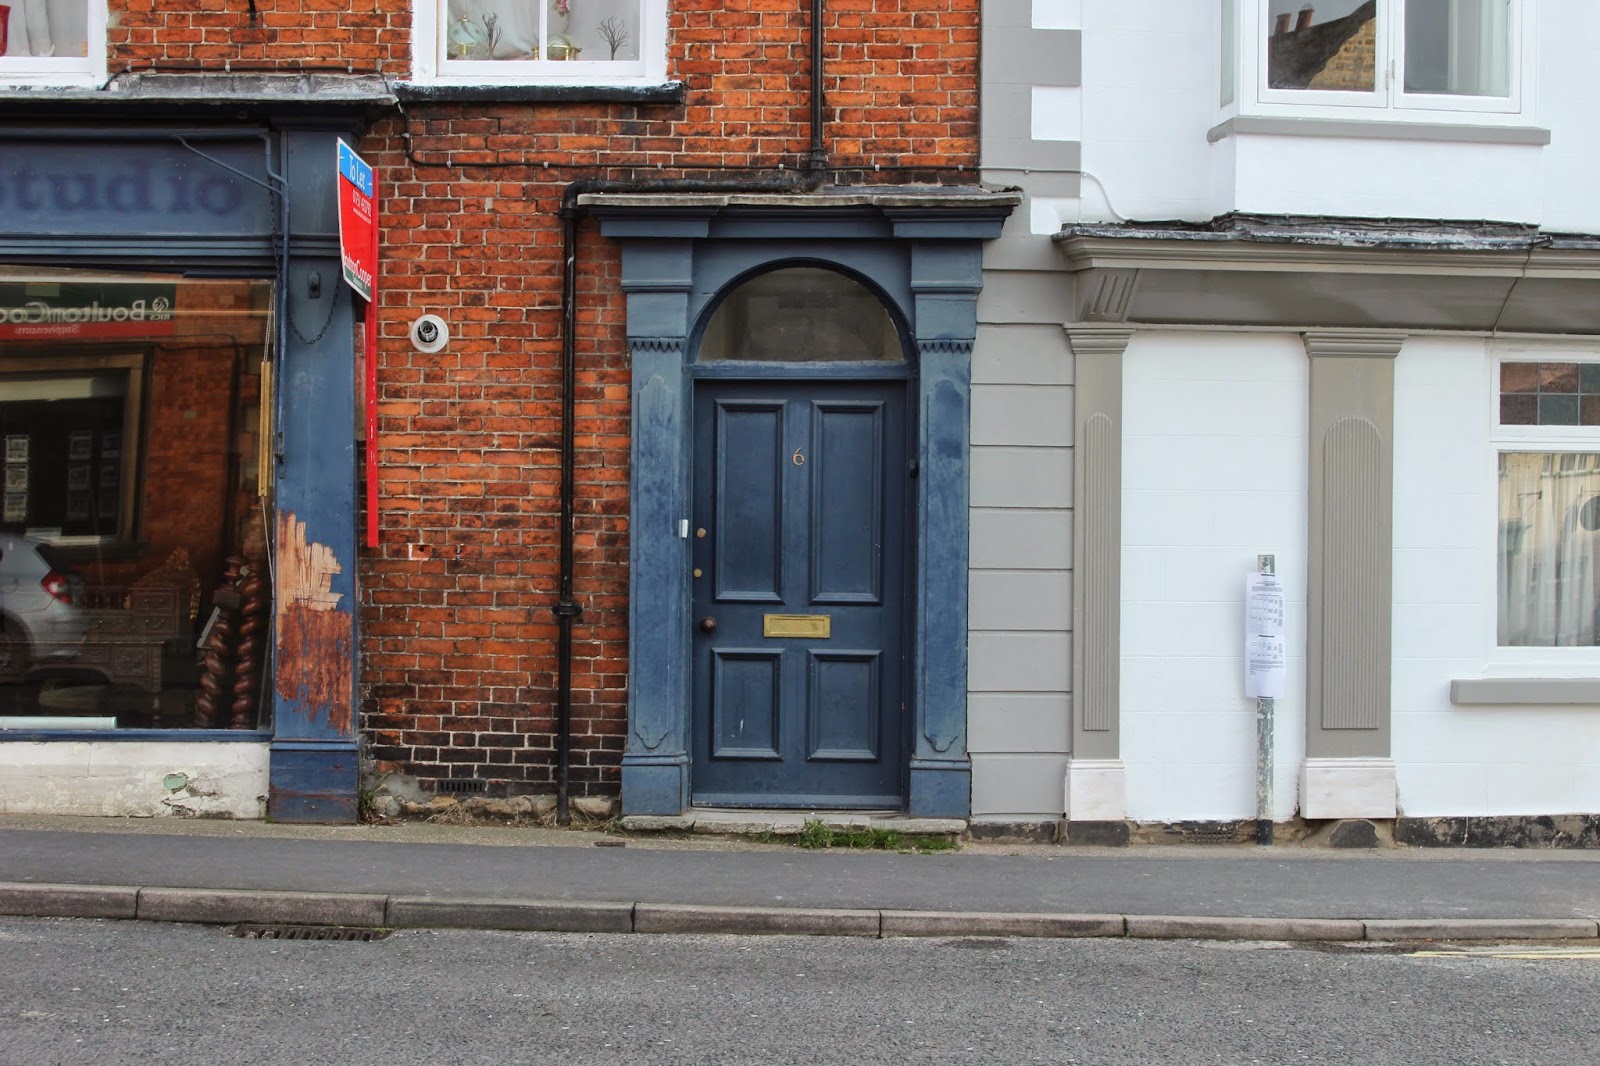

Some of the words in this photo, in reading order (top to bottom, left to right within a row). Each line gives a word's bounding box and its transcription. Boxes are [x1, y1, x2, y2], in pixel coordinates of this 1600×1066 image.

[0, 159, 243, 216] tudio
[349, 154, 356, 181] To
[356, 161, 366, 190] Let
[792, 447, 805, 466] 6
